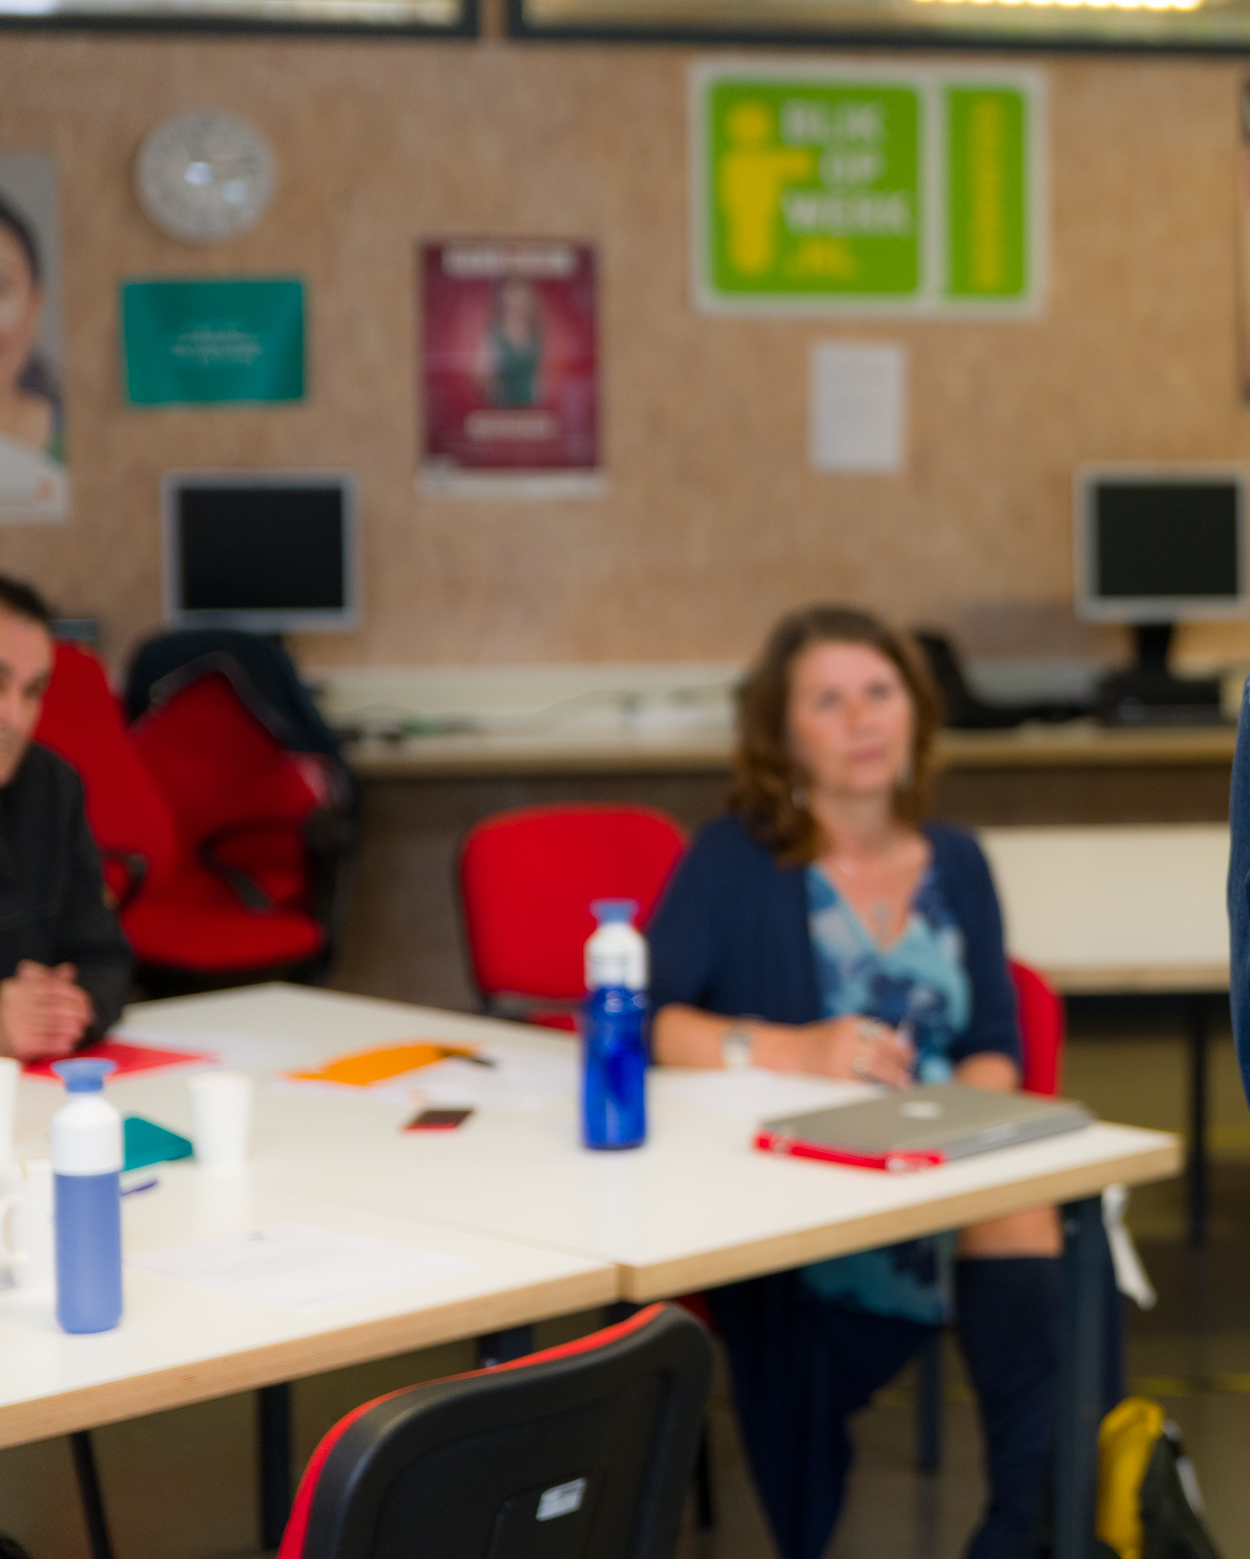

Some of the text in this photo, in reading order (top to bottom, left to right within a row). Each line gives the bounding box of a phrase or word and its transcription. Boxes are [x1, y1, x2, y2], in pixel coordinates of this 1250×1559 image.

[784, 101, 883, 144] BLIK
[822, 149, 883, 186] OP
[783, 192, 909, 234] WERK
